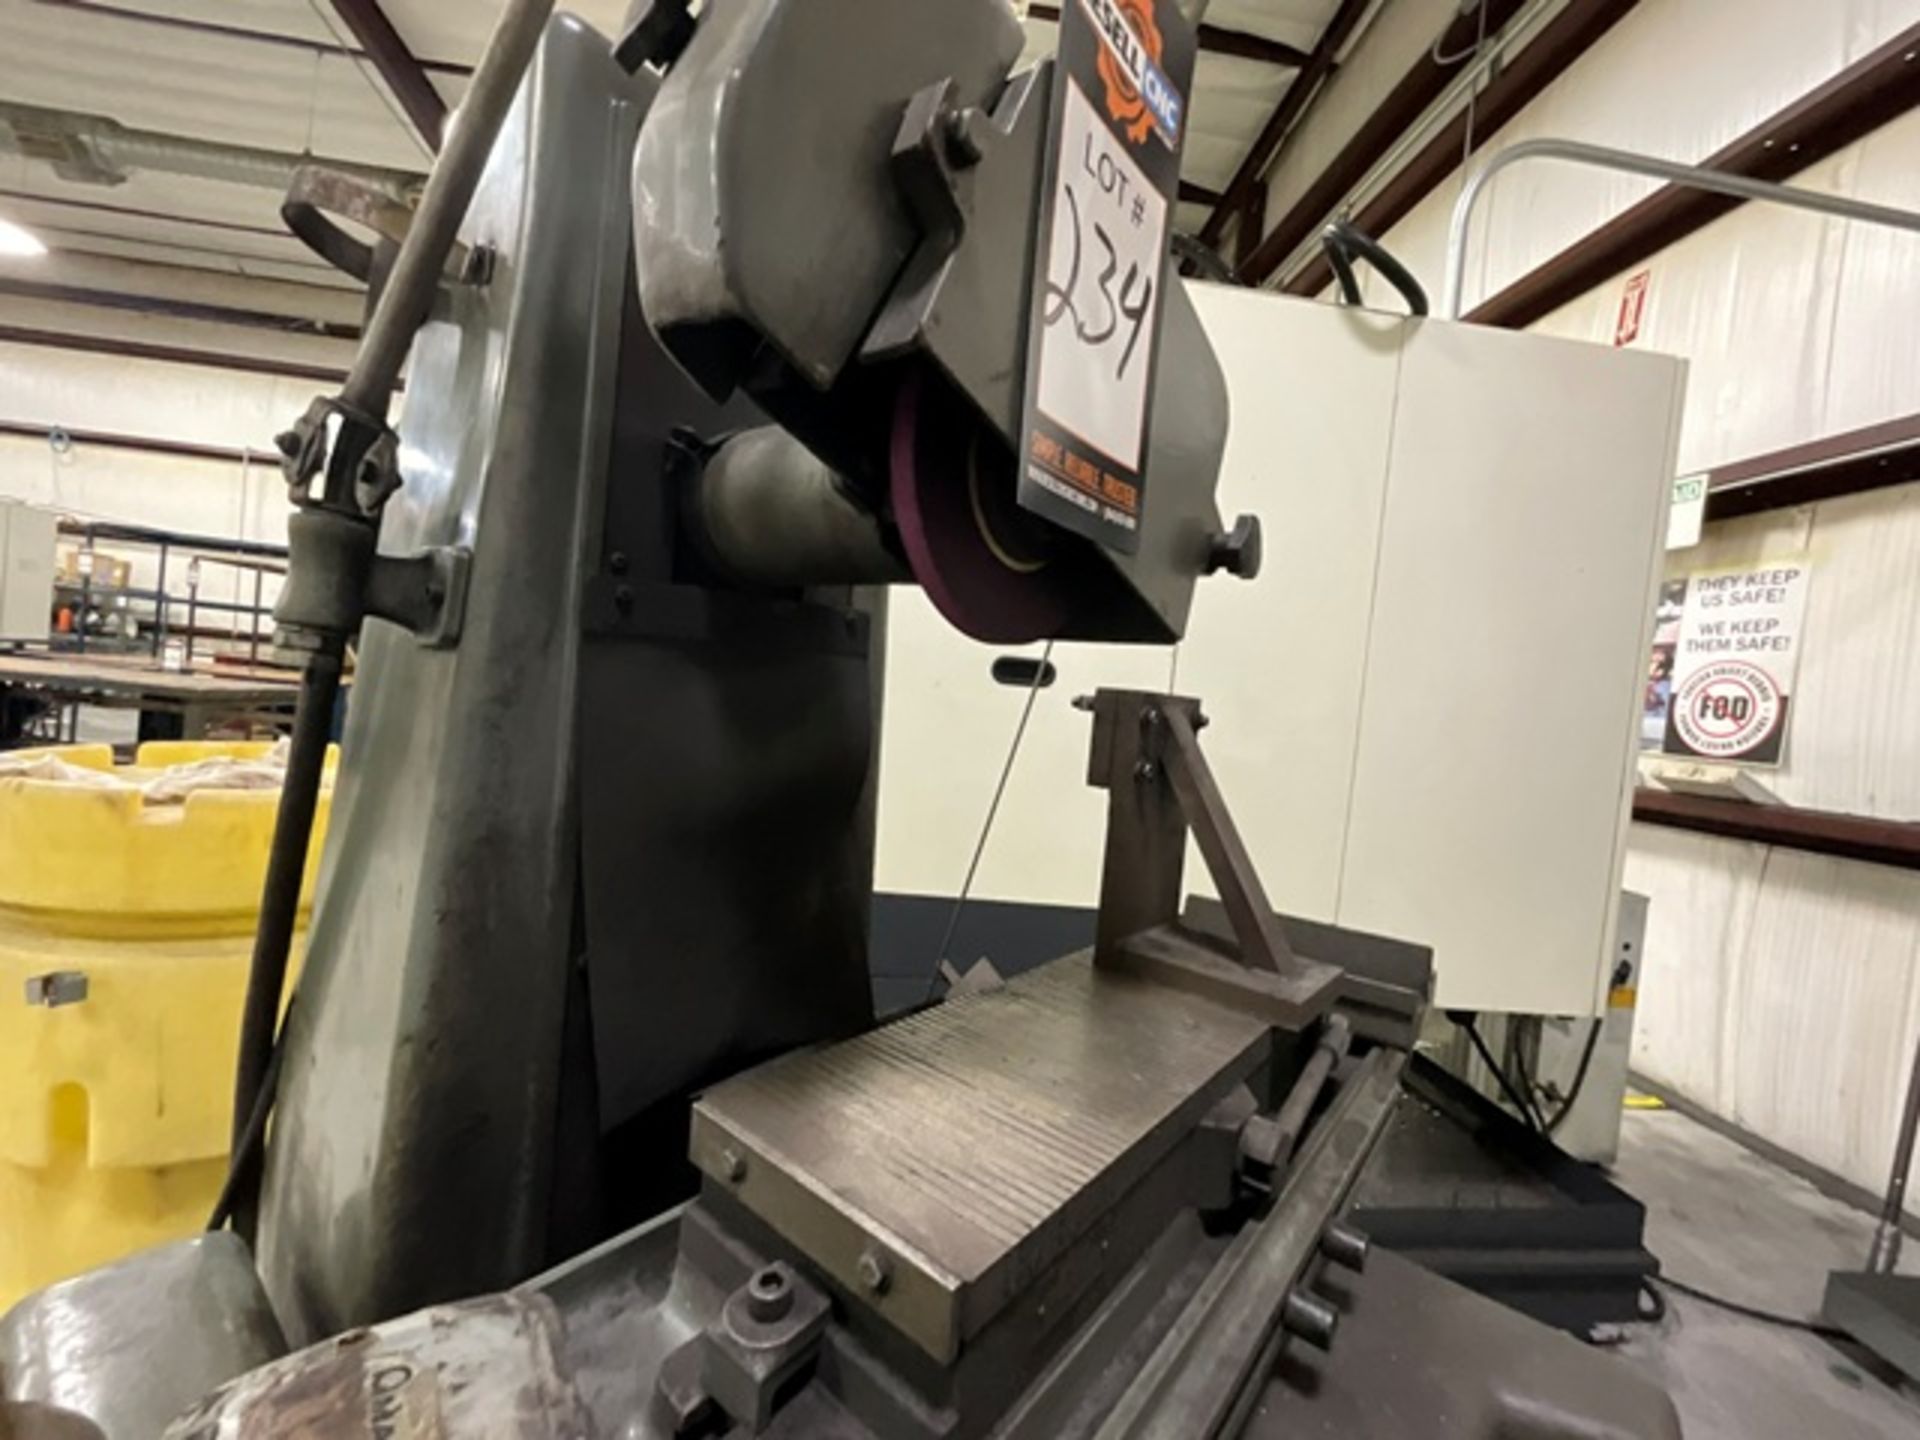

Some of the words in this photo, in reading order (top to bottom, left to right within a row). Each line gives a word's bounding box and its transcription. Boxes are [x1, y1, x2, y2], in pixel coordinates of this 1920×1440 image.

[1084, 131, 1129, 208] LOT
[1131, 193, 1147, 228] #
[1043, 183, 1152, 380] 234
[1696, 575, 1742, 593] THEY
[1745, 569, 1801, 587] KEEP
[1700, 593, 1723, 608] US
[1729, 588, 1787, 606] SAFE!
[1699, 621, 1726, 636] WE
[1730, 618, 1780, 634] KEEP
[1686, 638, 1731, 653] THEM
[1735, 636, 1791, 651] SAFE!
[1699, 694, 1749, 722] FOD
